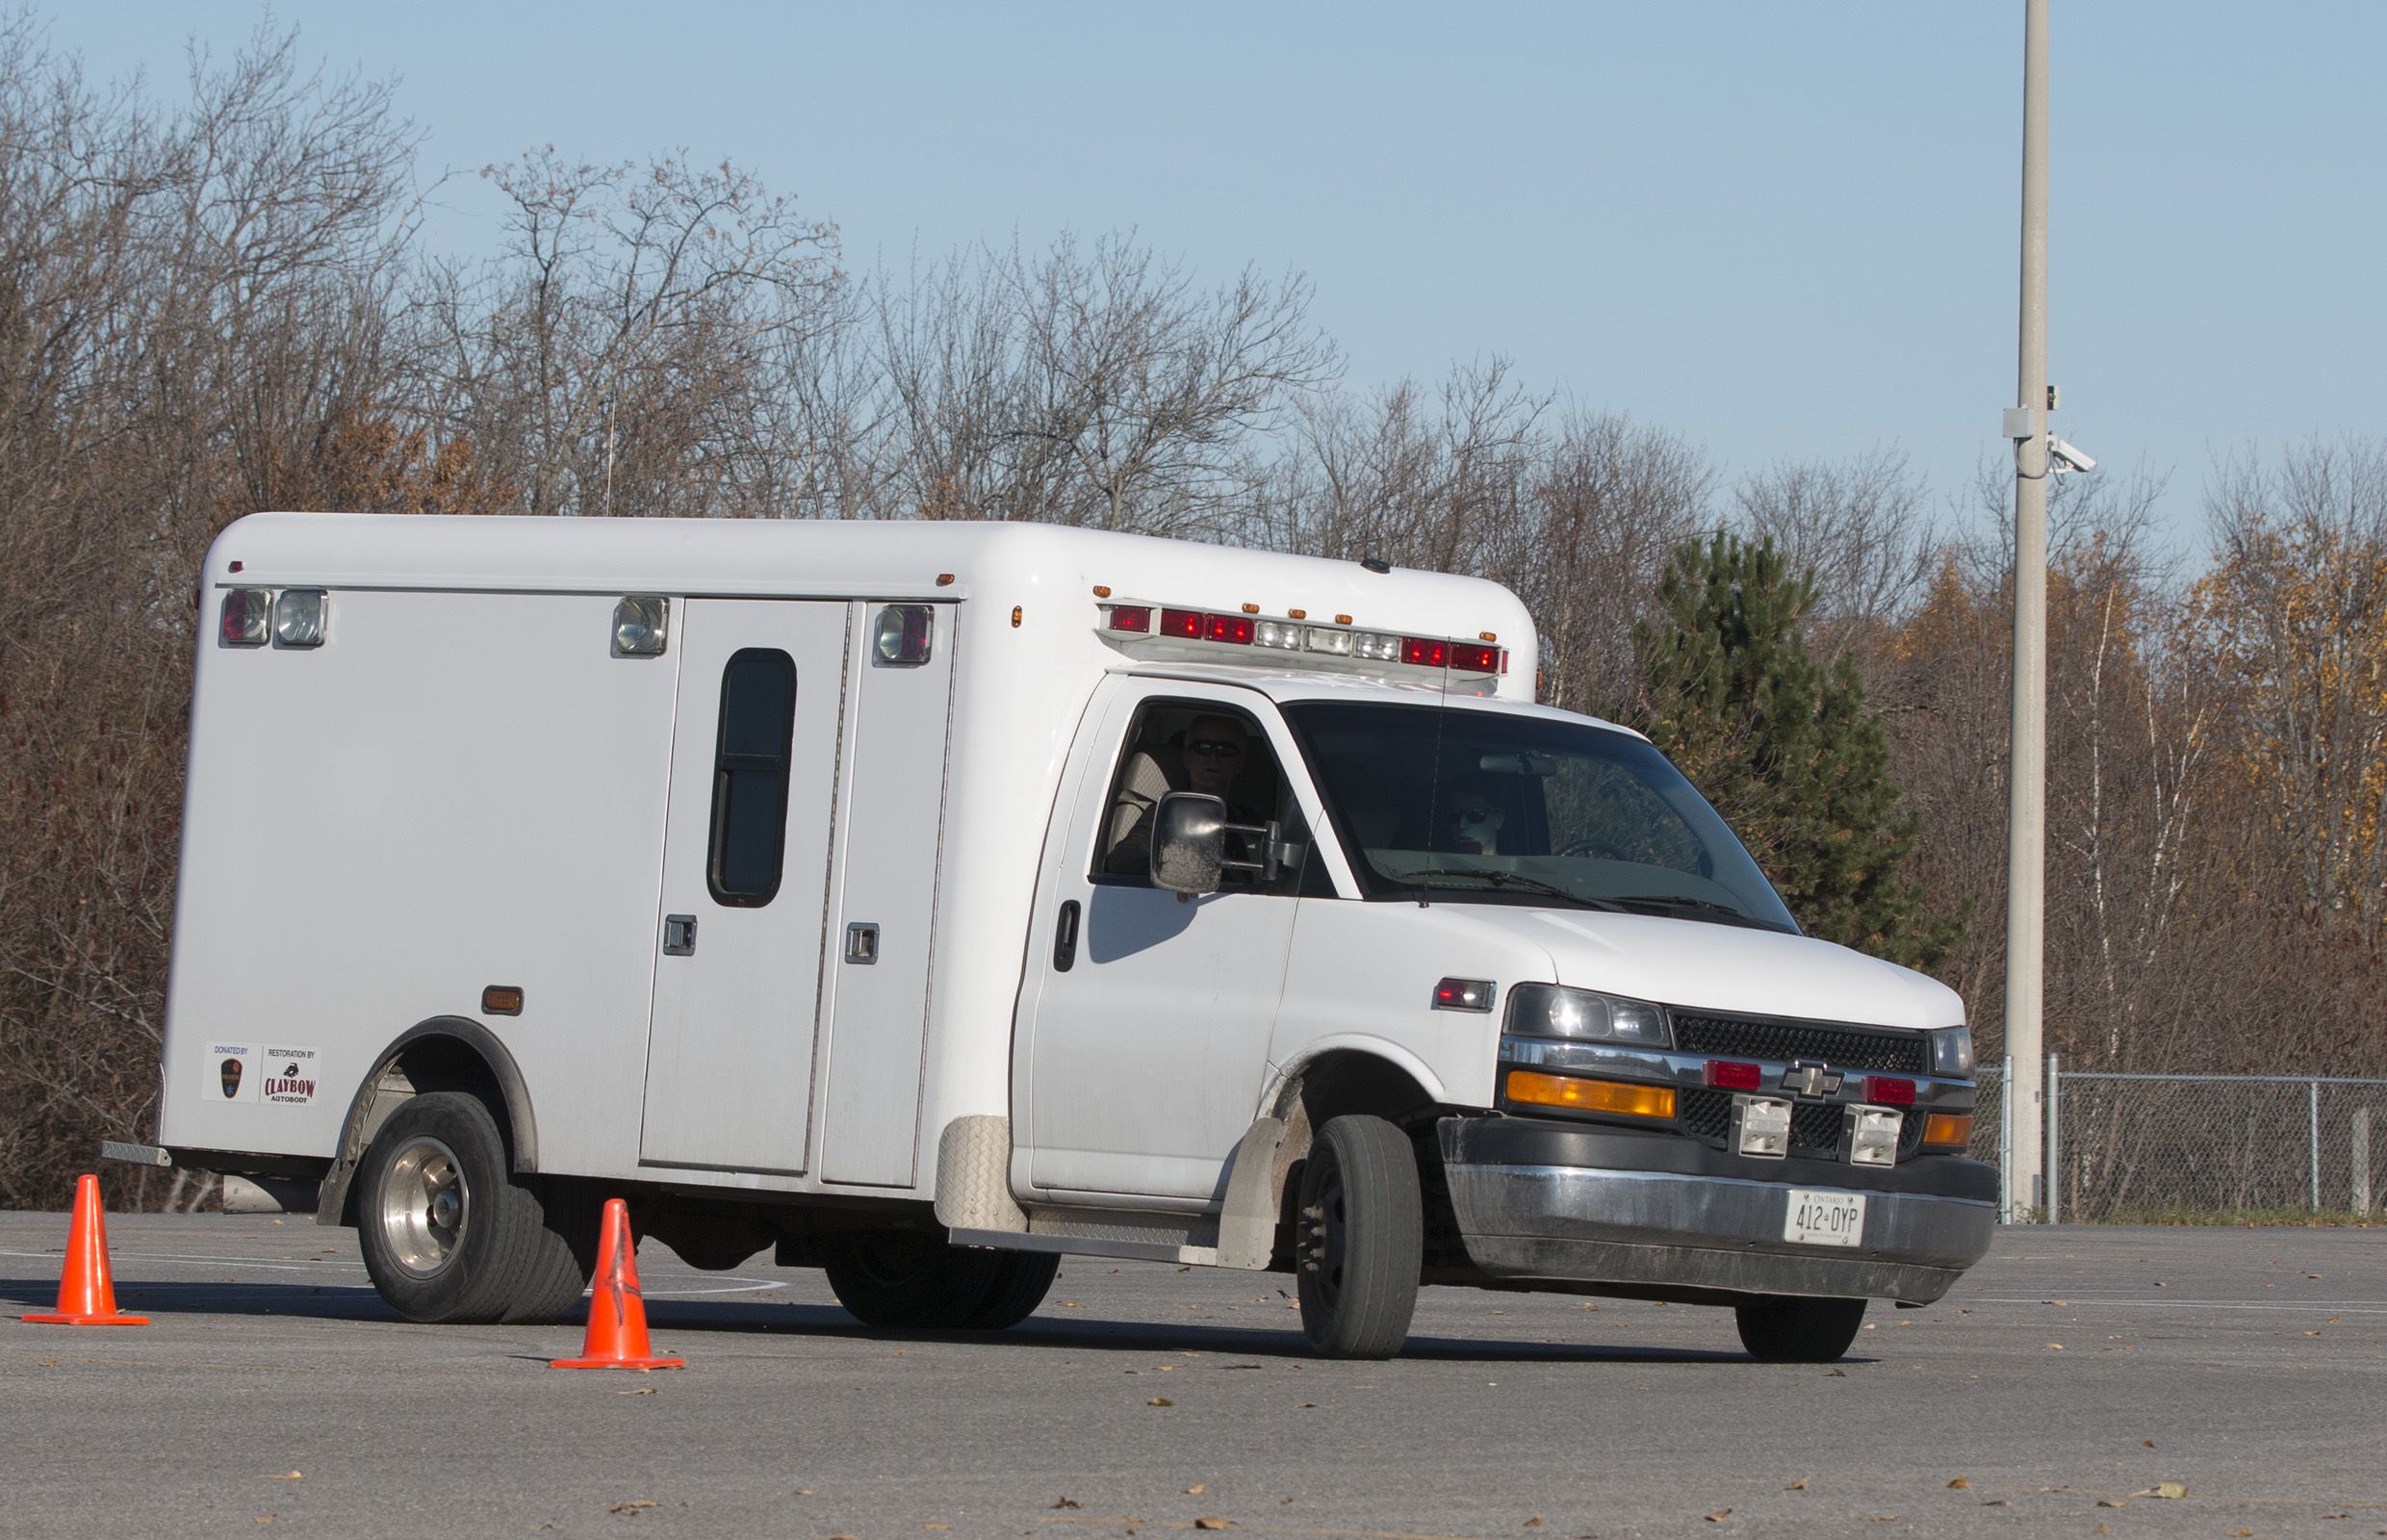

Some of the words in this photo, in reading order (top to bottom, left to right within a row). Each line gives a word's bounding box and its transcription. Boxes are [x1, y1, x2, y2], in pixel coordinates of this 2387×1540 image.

[215, 1045, 241, 1054] DONATED
[241, 1046, 248, 1055] BY
[269, 1049, 306, 1058] RESTORATION
[265, 1078, 316, 1098] CLAYBOW
[1796, 1204, 1823, 1230] 412
